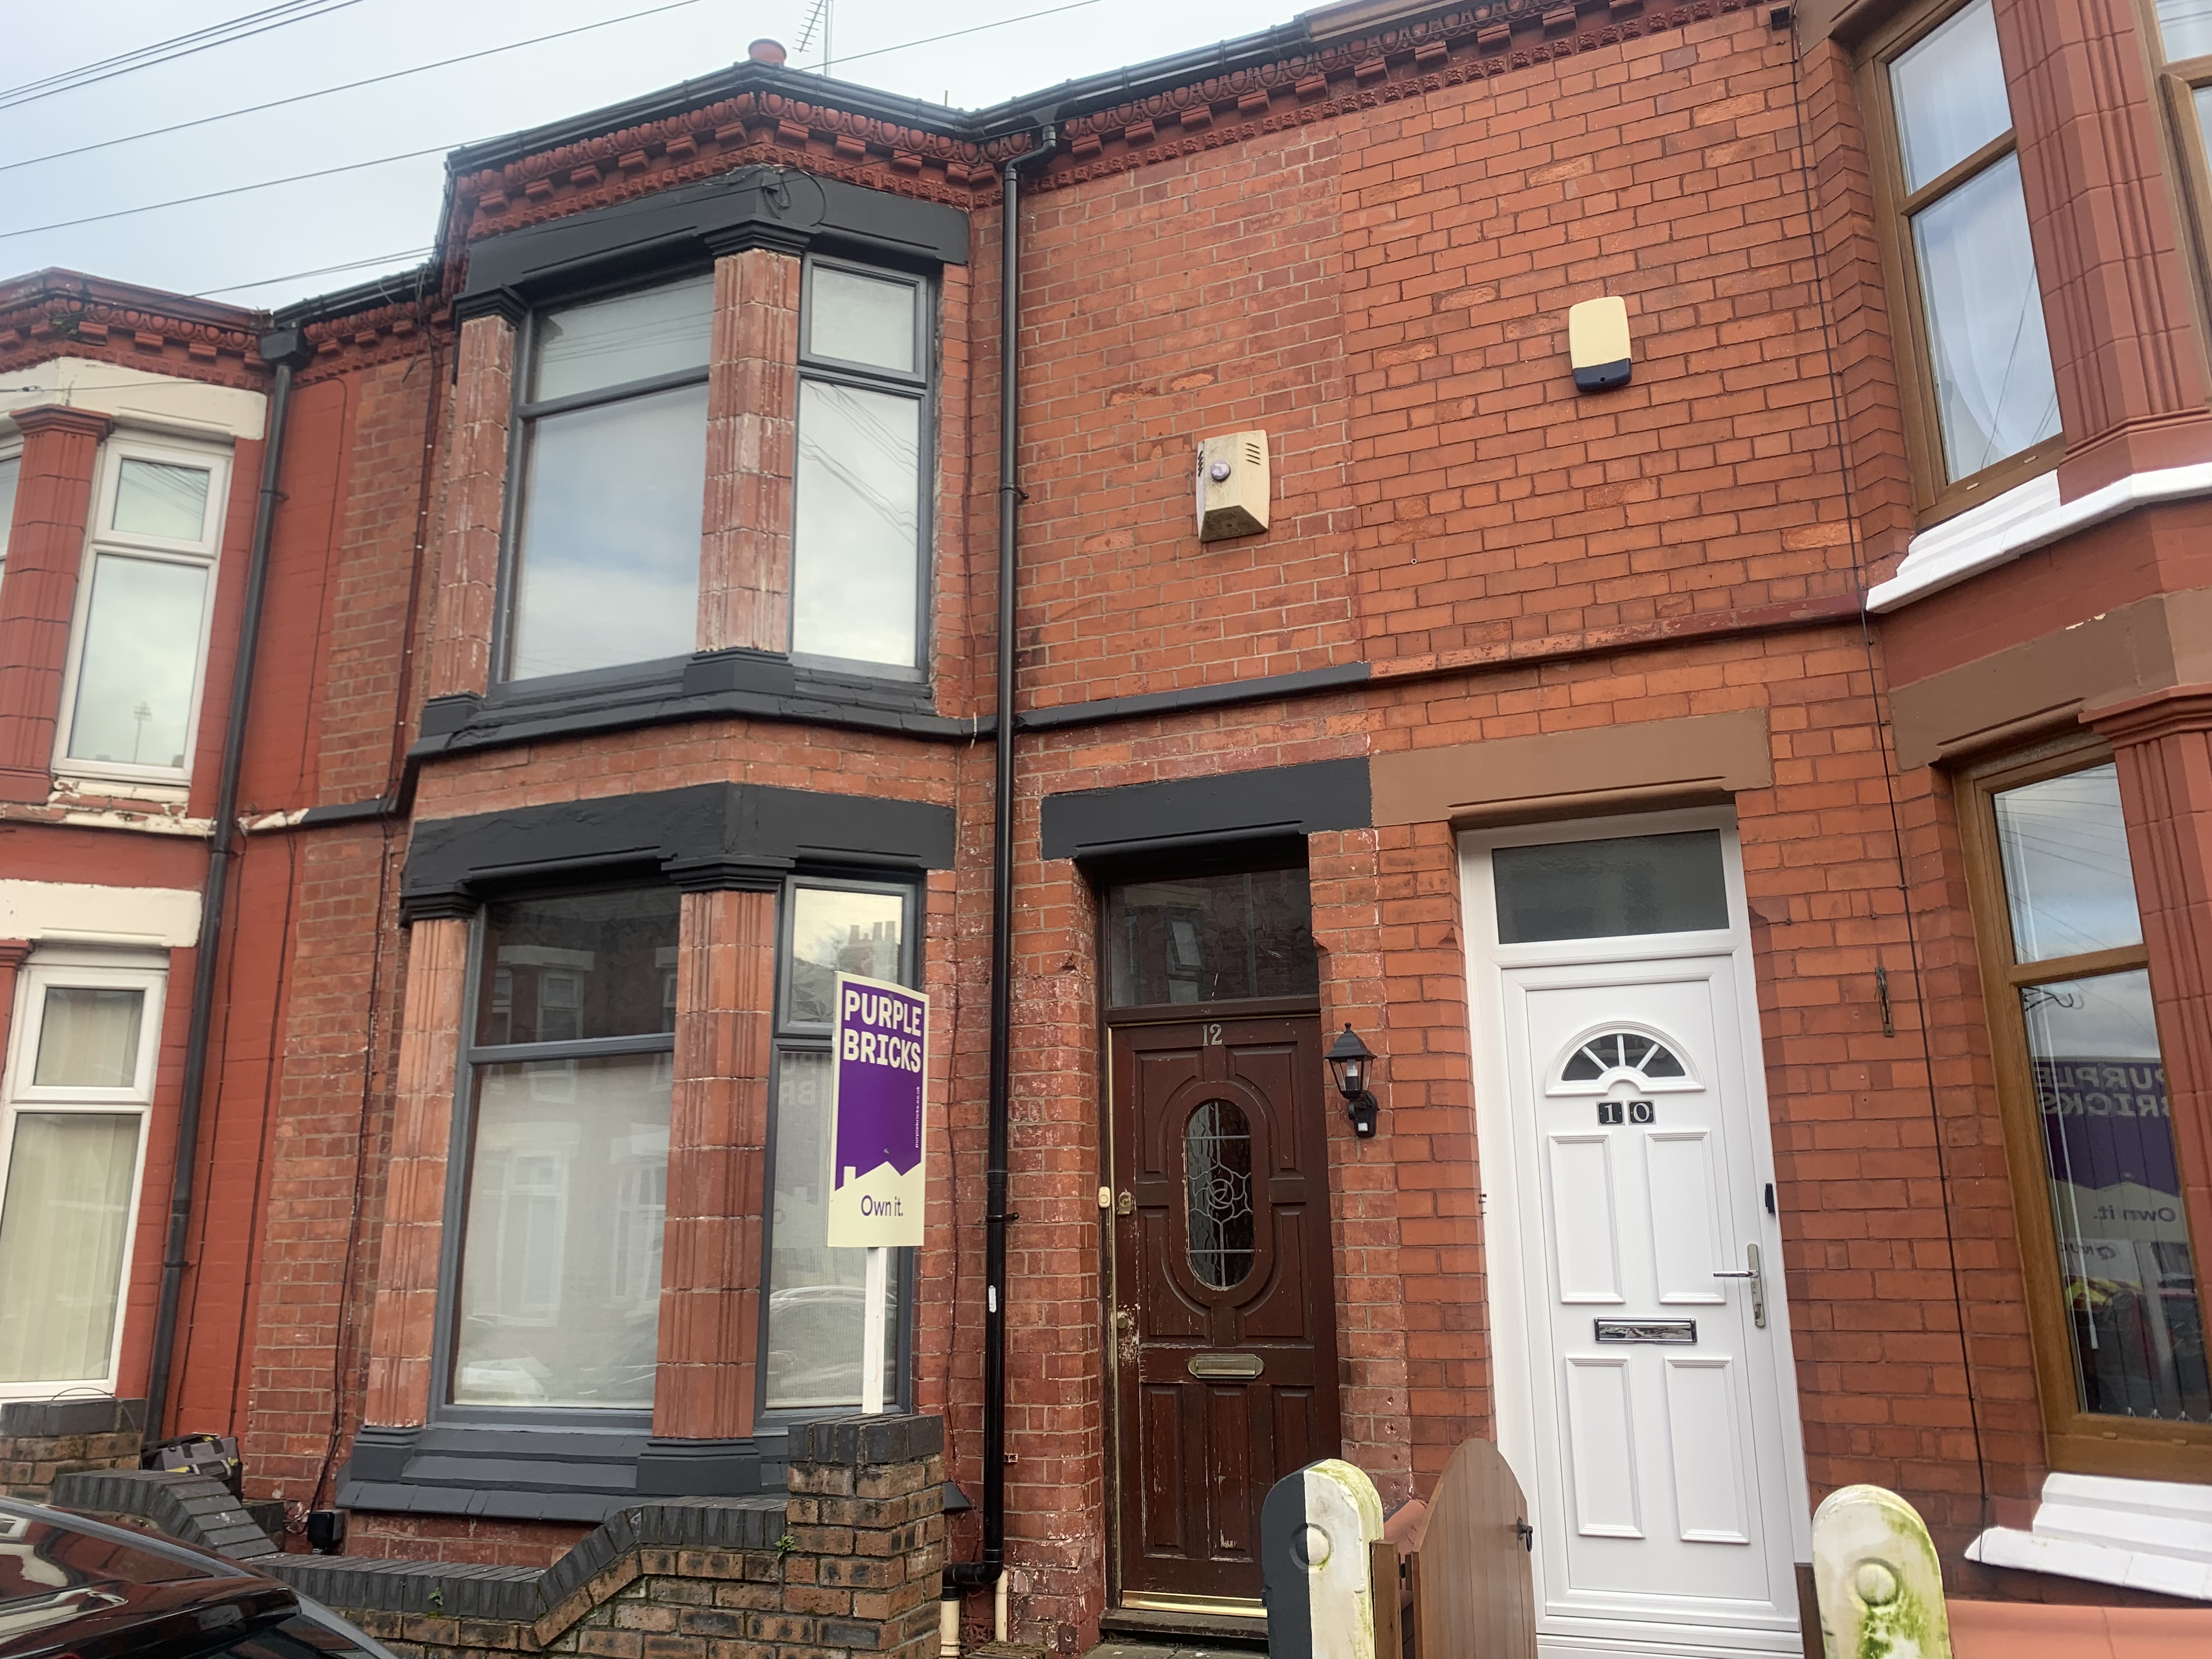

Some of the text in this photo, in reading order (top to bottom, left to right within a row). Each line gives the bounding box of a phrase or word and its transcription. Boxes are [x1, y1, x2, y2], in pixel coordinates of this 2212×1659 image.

[844, 989, 922, 1037] PURPLE
[1202, 1023, 1223, 1046] 12
[843, 1028, 921, 1073] BRICKS
[1604, 1102, 1650, 1124] 10
[861, 1194, 904, 1217] Own it.
